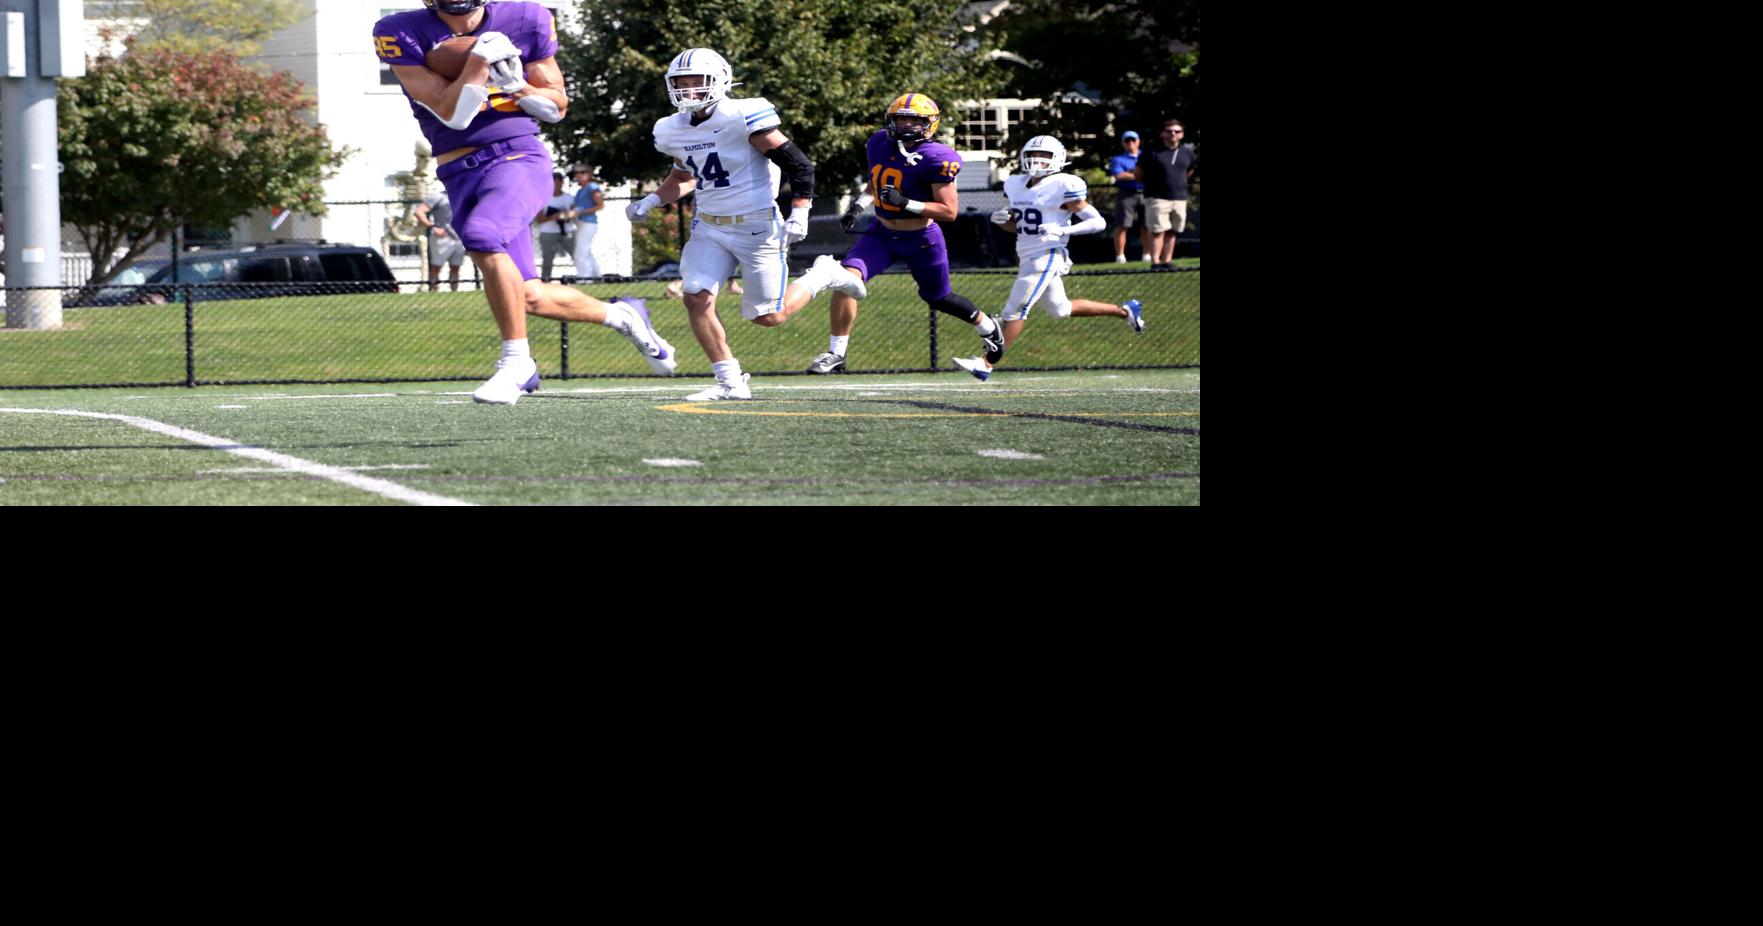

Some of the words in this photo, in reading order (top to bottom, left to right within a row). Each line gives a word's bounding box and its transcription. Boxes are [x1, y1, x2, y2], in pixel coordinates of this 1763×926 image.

[686, 152, 730, 190] 14
[939, 160, 961, 177] 19
[1011, 207, 1042, 235] 29
